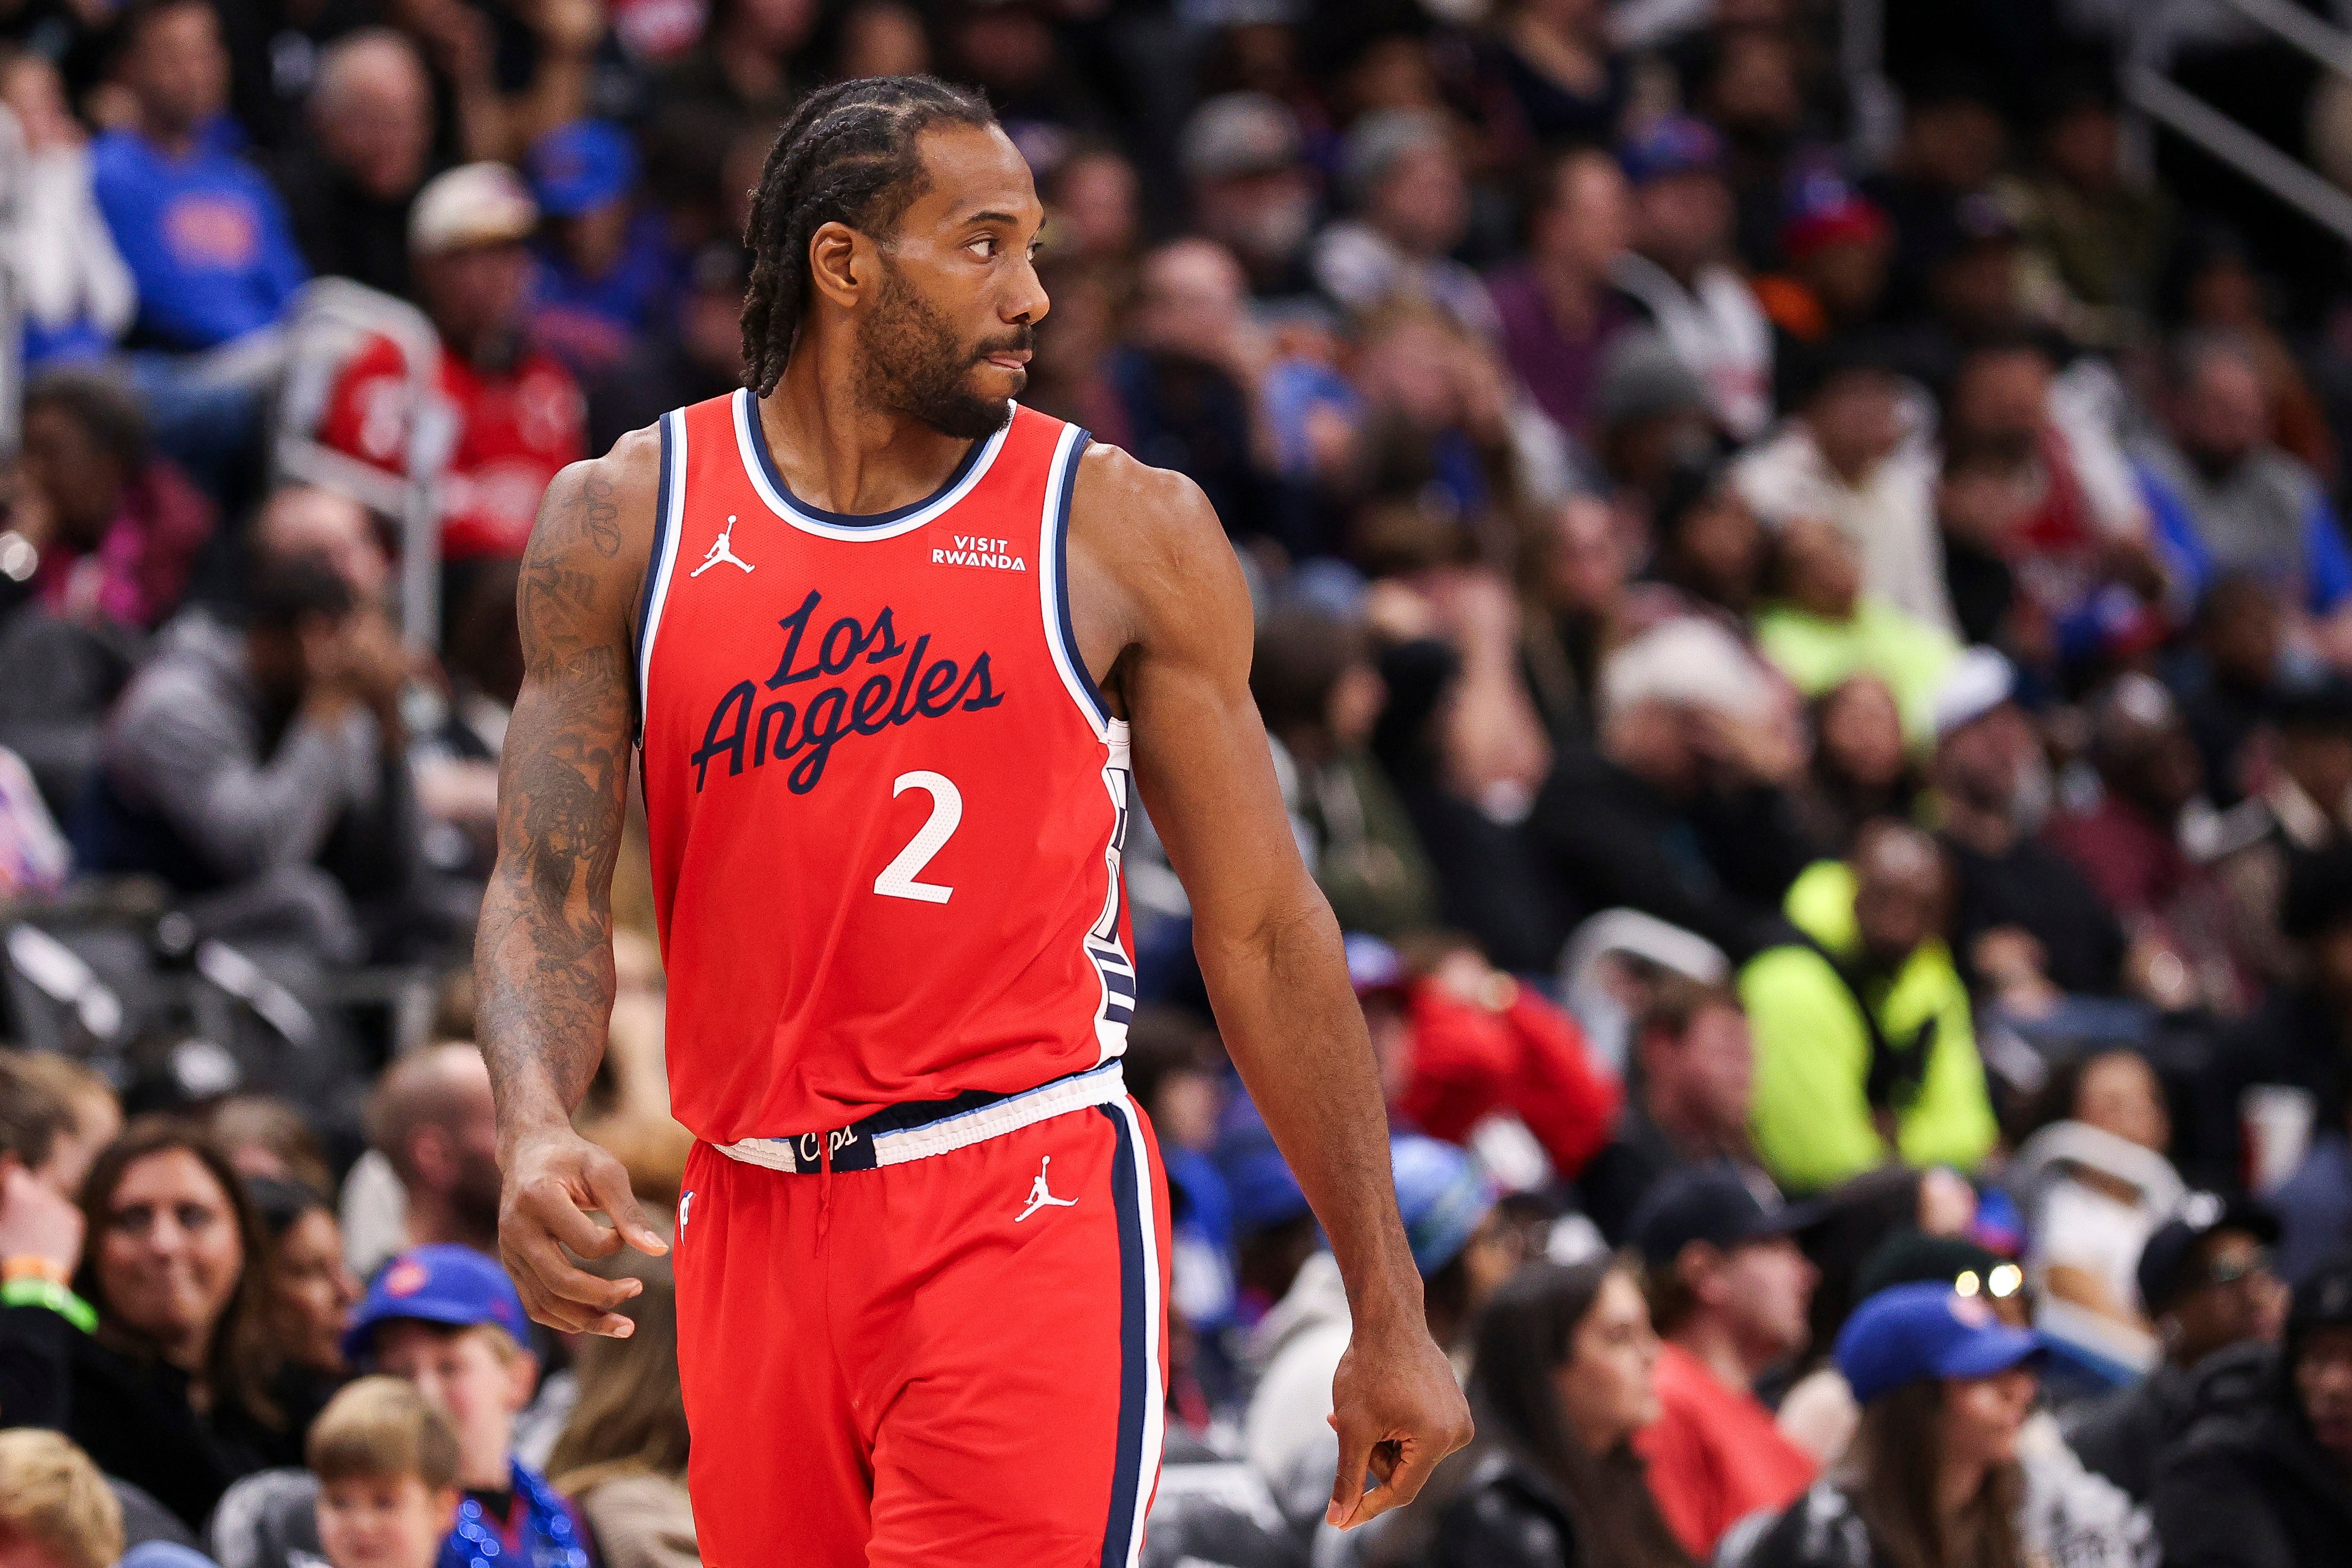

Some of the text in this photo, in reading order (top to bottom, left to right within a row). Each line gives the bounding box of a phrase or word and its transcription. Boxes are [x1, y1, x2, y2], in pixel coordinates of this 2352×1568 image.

[931, 548, 1026, 571] RWANDA
[953, 535, 1008, 554] VISIT
[764, 589, 906, 691] Los
[691, 634, 1005, 795] Angeles
[873, 771, 962, 904] 2
[800, 1125, 858, 1162] Cps
